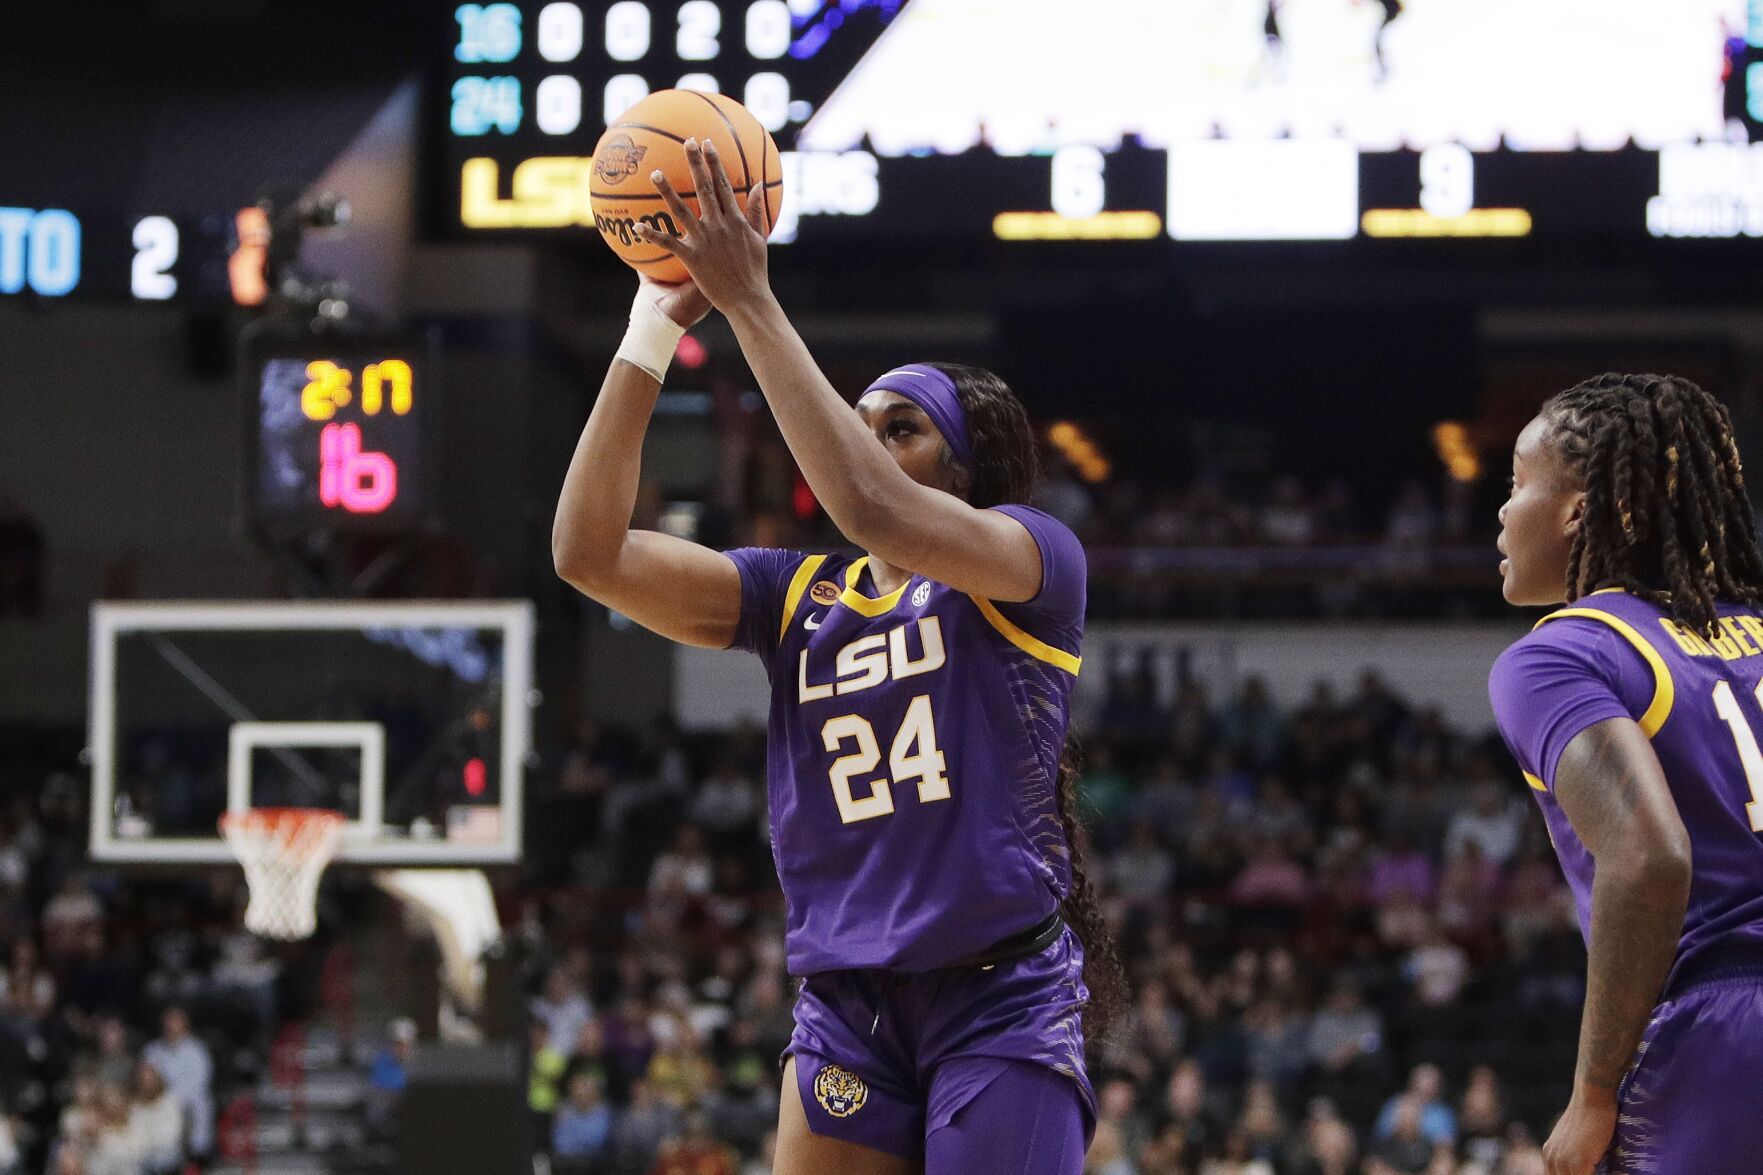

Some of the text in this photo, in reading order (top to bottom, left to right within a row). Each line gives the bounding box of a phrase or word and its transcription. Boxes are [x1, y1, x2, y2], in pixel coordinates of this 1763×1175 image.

[538, 2, 583, 62] 0
[605, 2, 651, 61] 0
[676, 1, 721, 60] 2
[745, 0, 791, 59] 0
[450, 76, 523, 135] 24
[537, 75, 581, 135] 0
[461, 156, 594, 228] LS
[1051, 144, 1104, 218] 6
[1419, 141, 1473, 217] 9
[132, 216, 179, 299] 2
[799, 615, 946, 704] LSU
[821, 694, 952, 824] 24
[1712, 677, 1763, 832] 1
